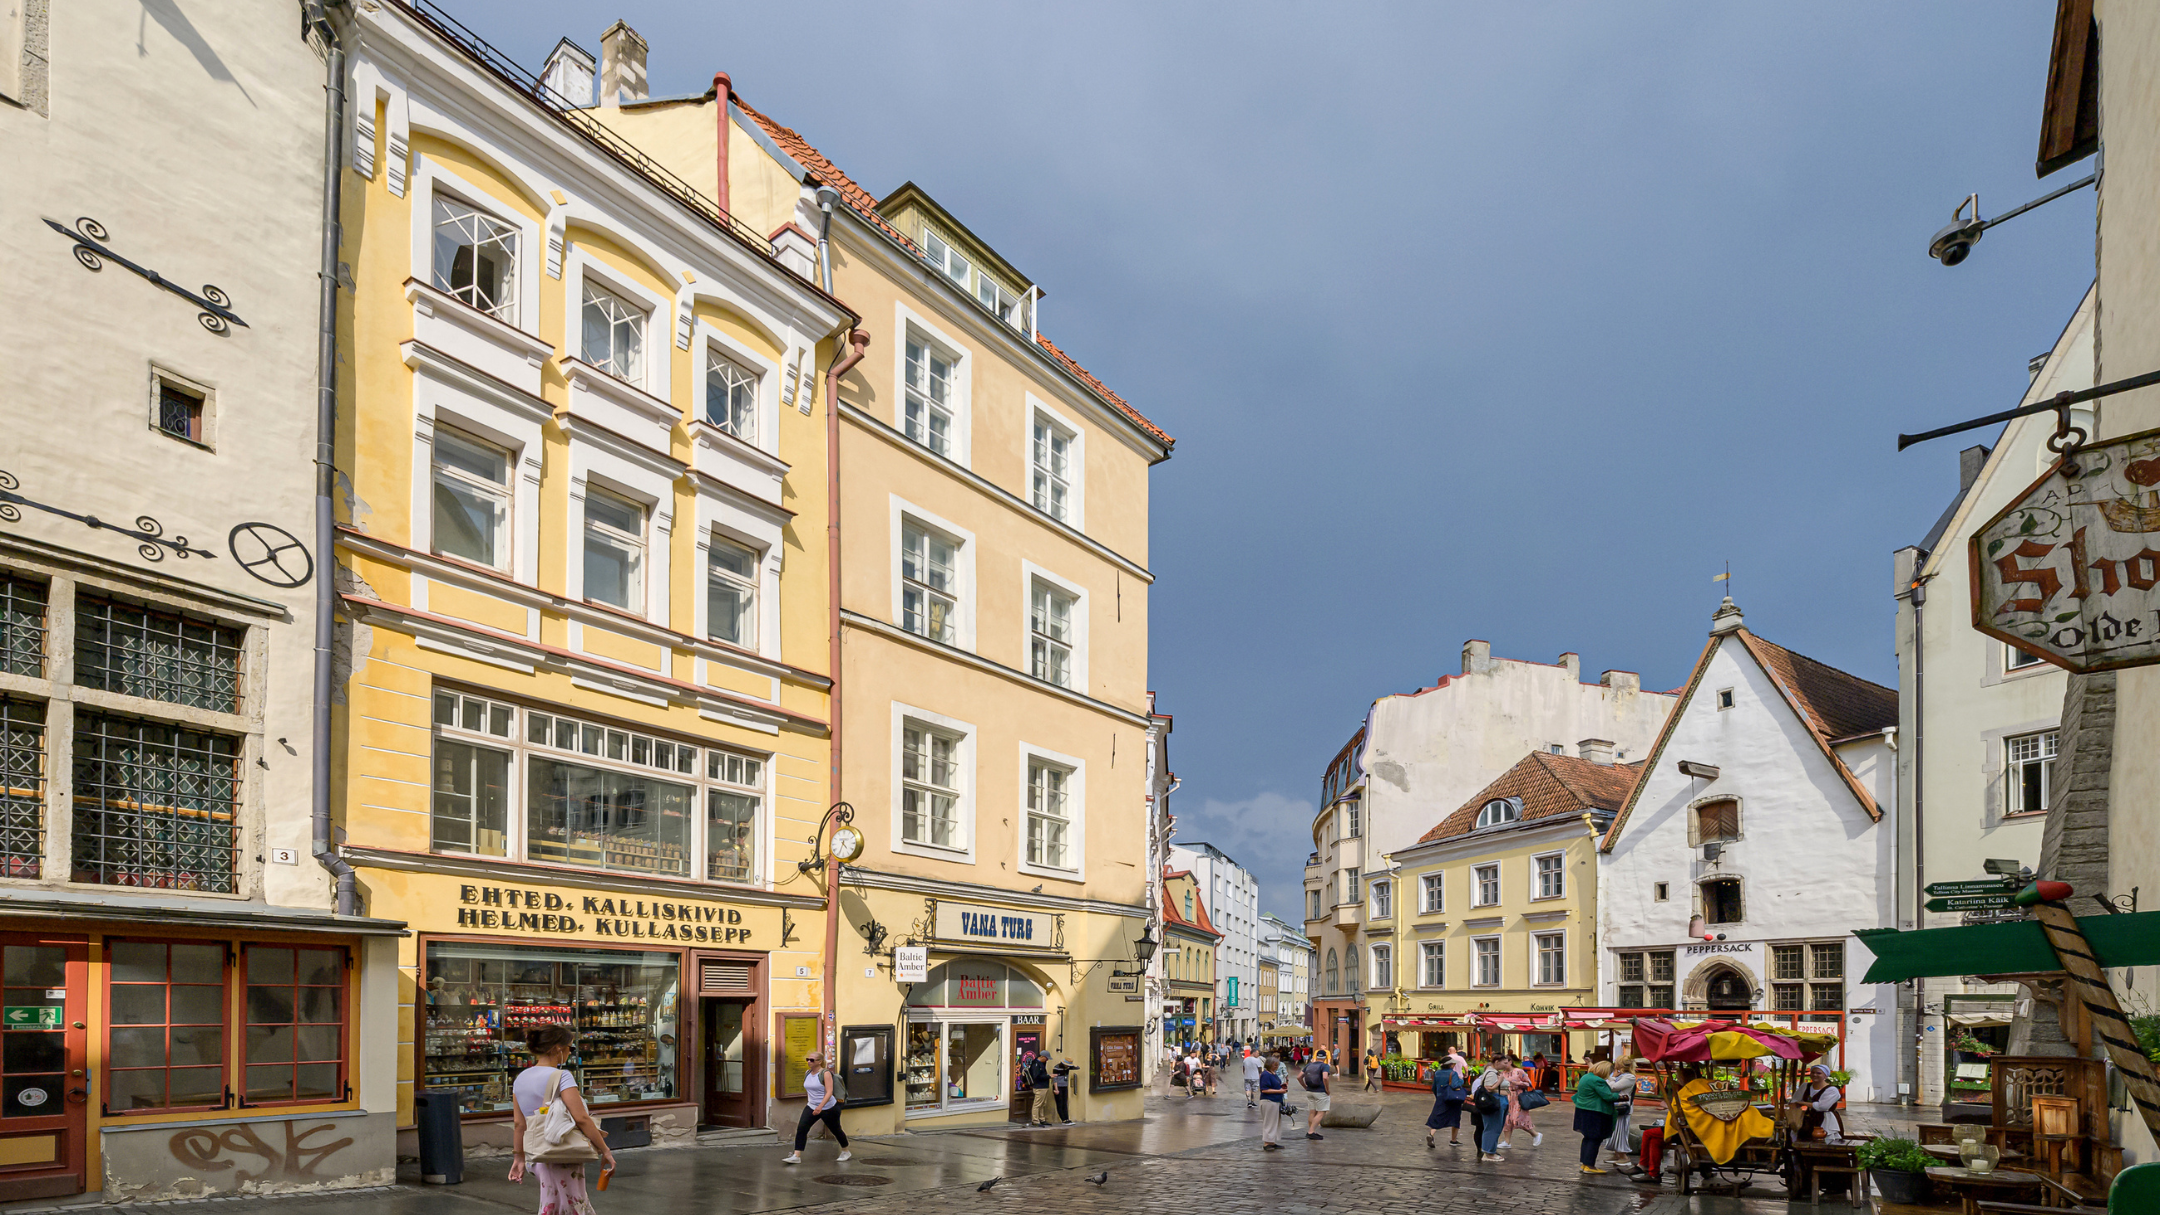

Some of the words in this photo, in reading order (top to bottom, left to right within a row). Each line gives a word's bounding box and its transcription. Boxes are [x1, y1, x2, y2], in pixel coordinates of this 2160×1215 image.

[2048, 609, 2143, 648] Olde
[280, 851, 289, 861] 3
[582, 896, 742, 925] KALLISKIVID
[595, 918, 752, 944] KULLASSEPP
[961, 912, 997, 938] VANA
[1001, 916, 1033, 940] TURG
[1687, 943, 1752, 954] PEPPERSACK
[900, 952, 923, 961] Baltic
[898, 962, 925, 971] Amber
[960, 974, 997, 989] Baltic
[957, 986, 997, 1000] Amber
[1017, 1015, 1040, 1024] BAAR
